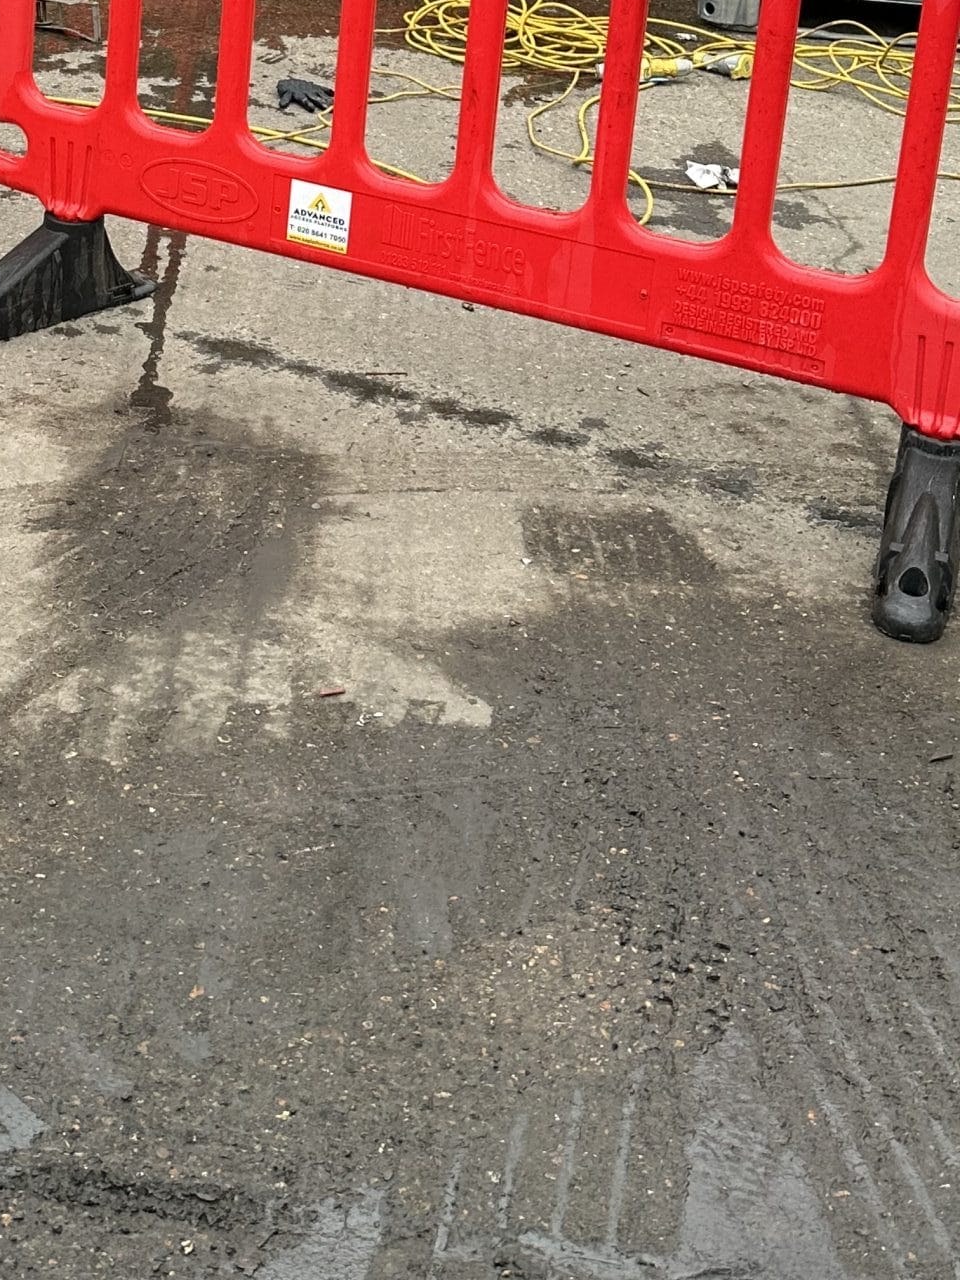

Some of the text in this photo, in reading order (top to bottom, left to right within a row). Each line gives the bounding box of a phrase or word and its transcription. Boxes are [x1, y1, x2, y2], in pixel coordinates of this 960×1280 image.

[156, 167, 239, 210] JSP
[293, 208, 345, 226] ADVANCED
[297, 225, 310, 235] 020
[419, 218, 526, 275] FirstFence
[676, 282, 822, 329] +44 1993 824000
[677, 268, 825, 312] www.jspsafety.com
[673, 300, 817, 344] DESIGN REGISTERED AND
[673, 313, 703, 330] MADE
[719, 323, 739, 338] THE
[741, 329, 757, 342] UK
[758, 333, 773, 346] BY
[775, 337, 793, 351] JSP
[796, 342, 816, 357] LTD
